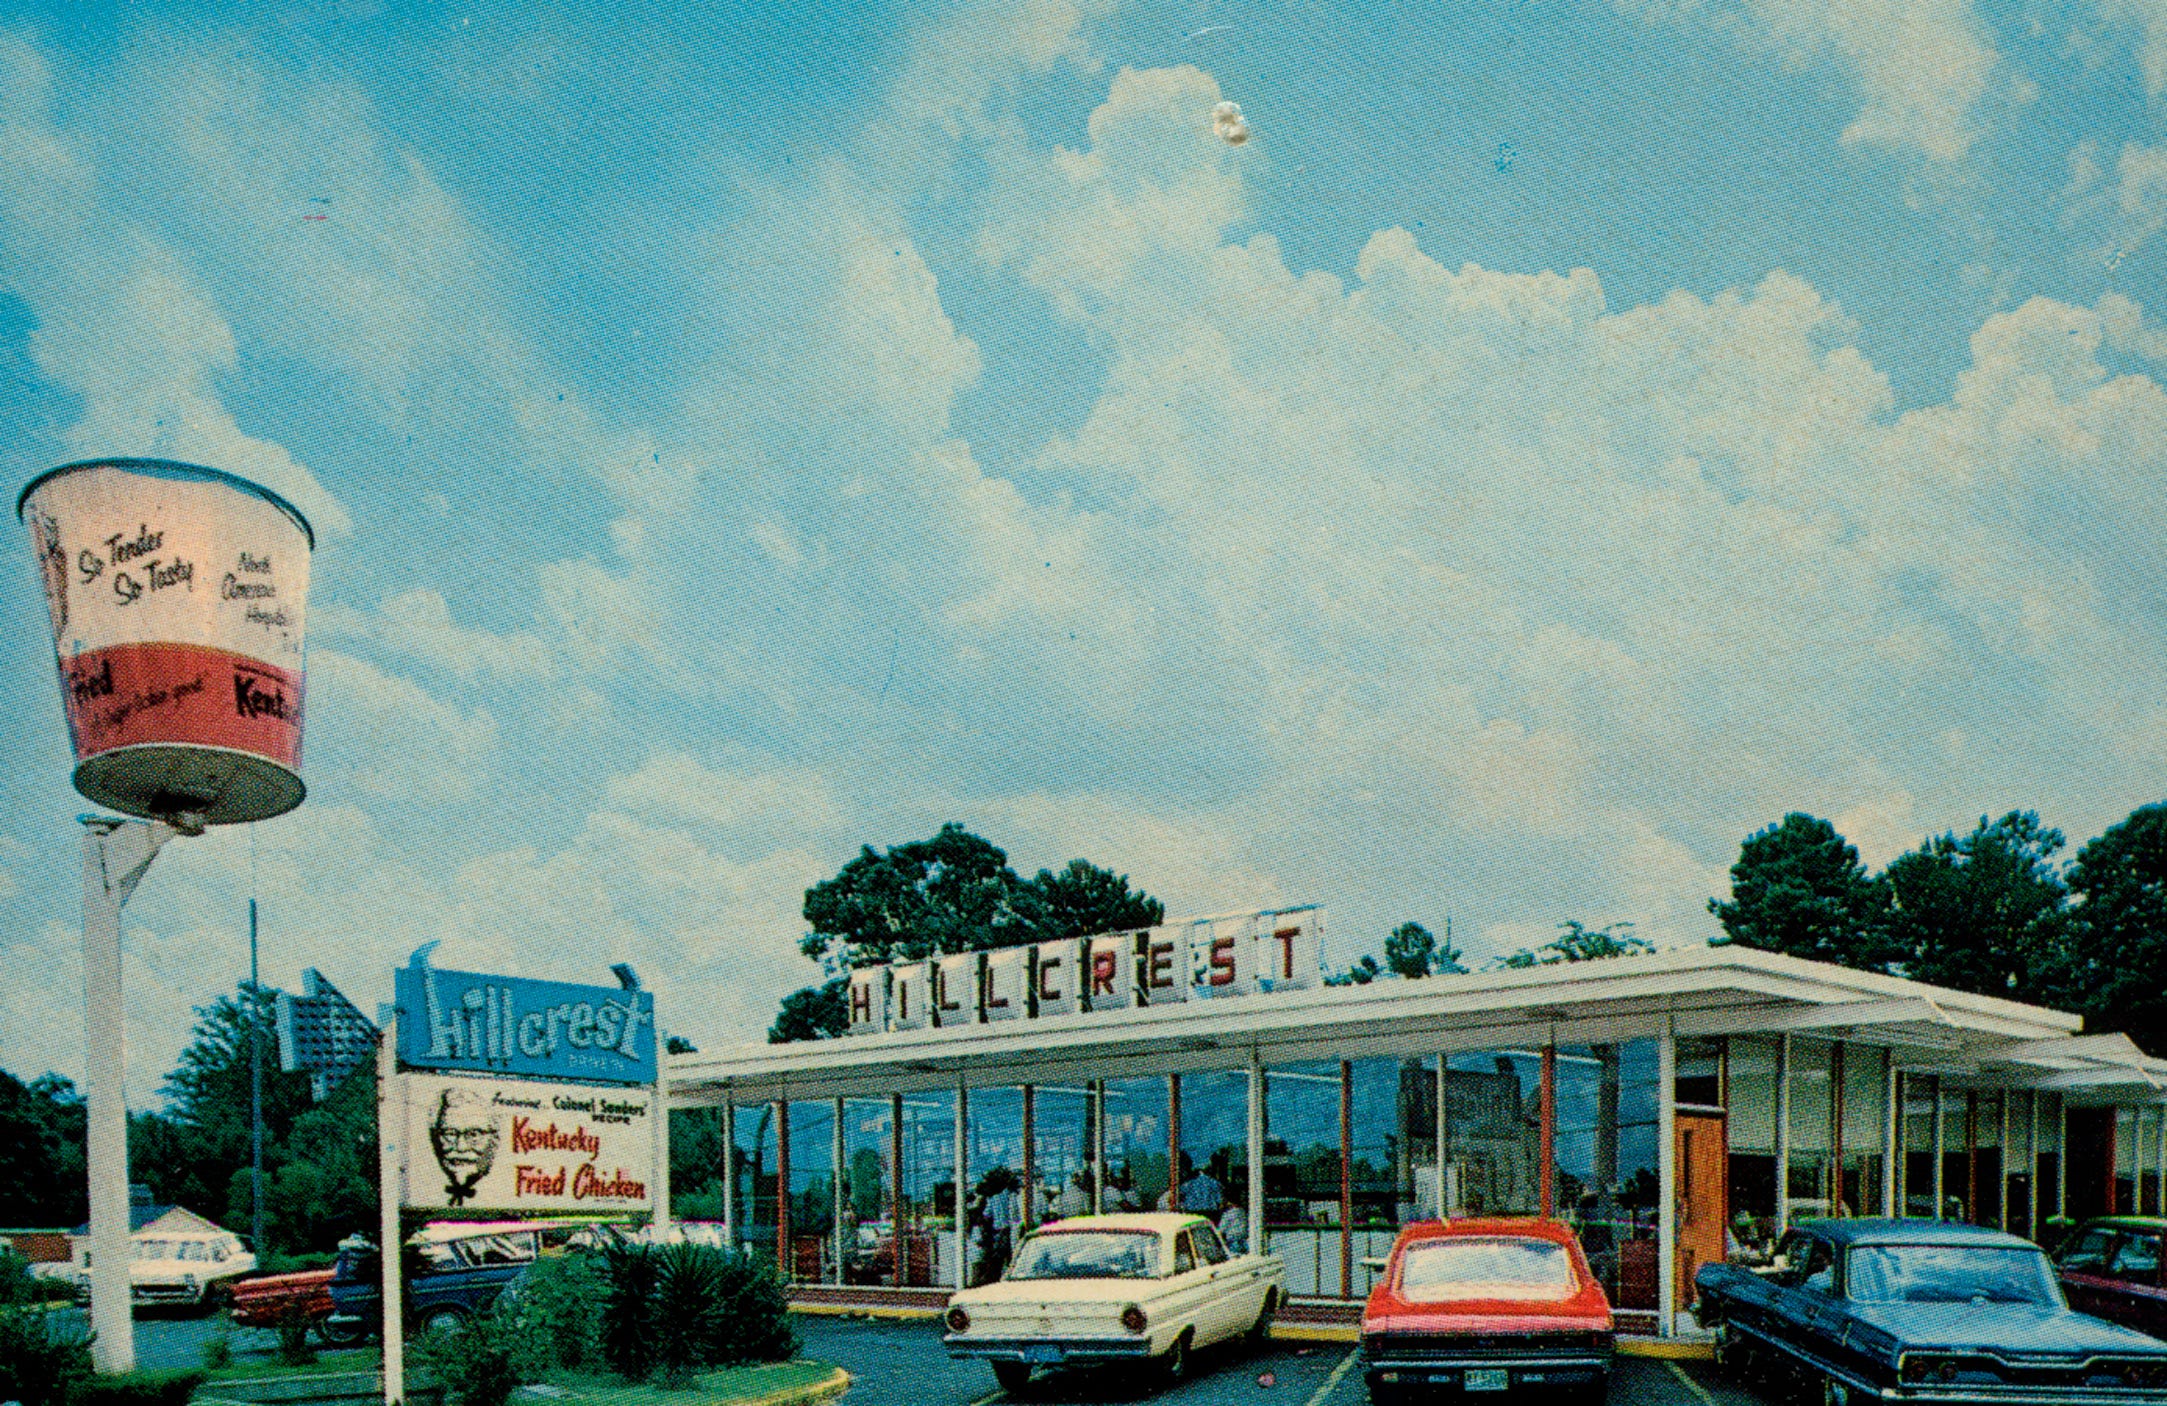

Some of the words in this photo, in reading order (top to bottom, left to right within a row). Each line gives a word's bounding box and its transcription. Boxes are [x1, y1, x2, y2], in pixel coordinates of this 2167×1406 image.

[79, 548, 105, 584] So
[104, 523, 164, 566] Tender
[114, 571, 143, 606] So
[142, 556, 193, 593] Tasty
[849, 926, 1302, 1024] HILLCREST
[552, 1095, 596, 1113] Colonel
[511, 1115, 600, 1162] Kentucky
[514, 1163, 566, 1198] Fried
[572, 1162, 646, 1201] Chicken
